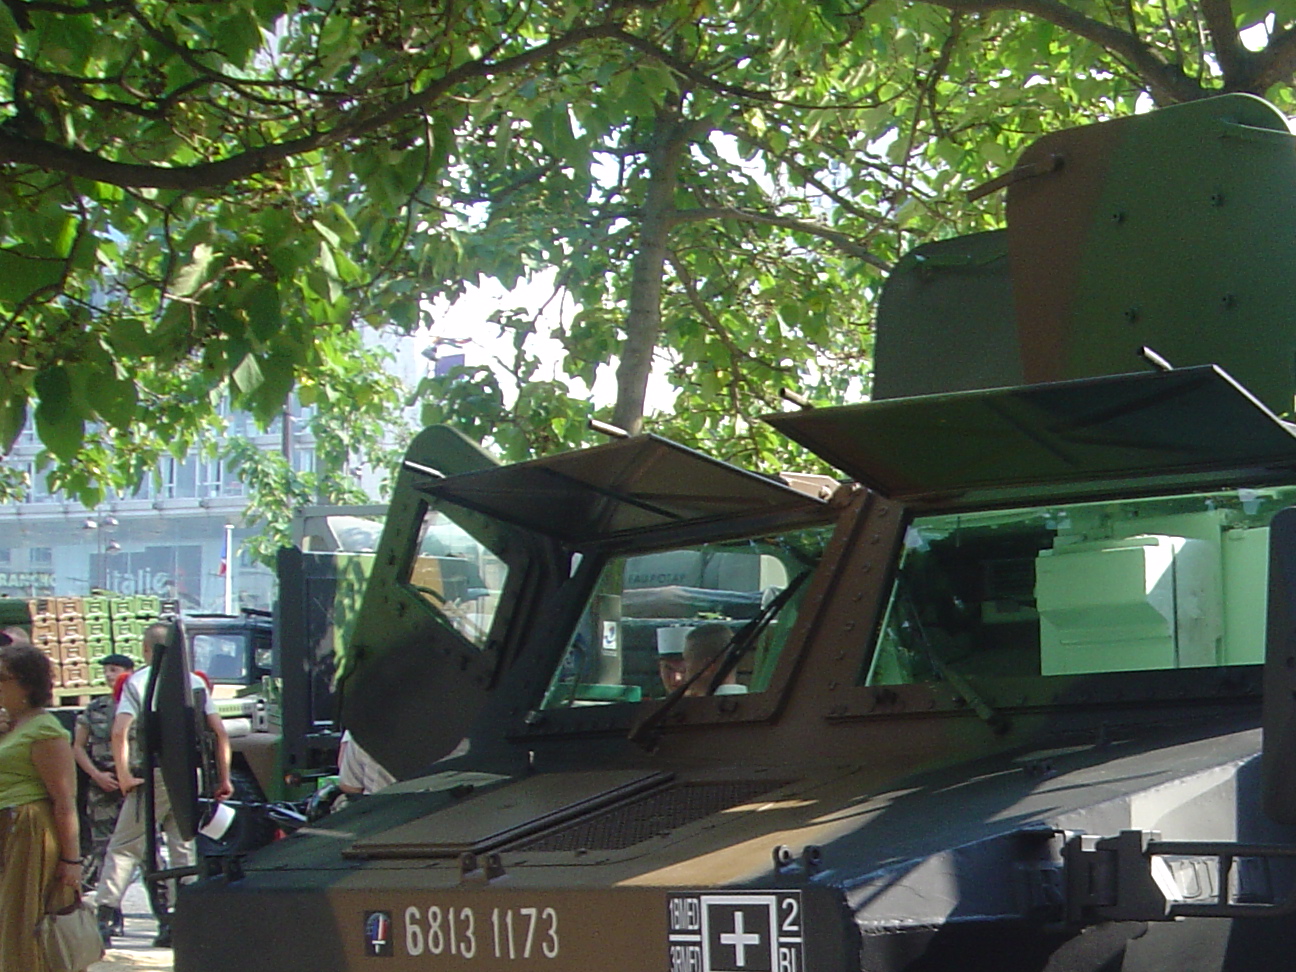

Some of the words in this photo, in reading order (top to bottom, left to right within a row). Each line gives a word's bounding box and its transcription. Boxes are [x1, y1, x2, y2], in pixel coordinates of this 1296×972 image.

[404, 905, 476, 959] 6813
[491, 907, 559, 960] 1173
[781, 898, 800, 931] 2
